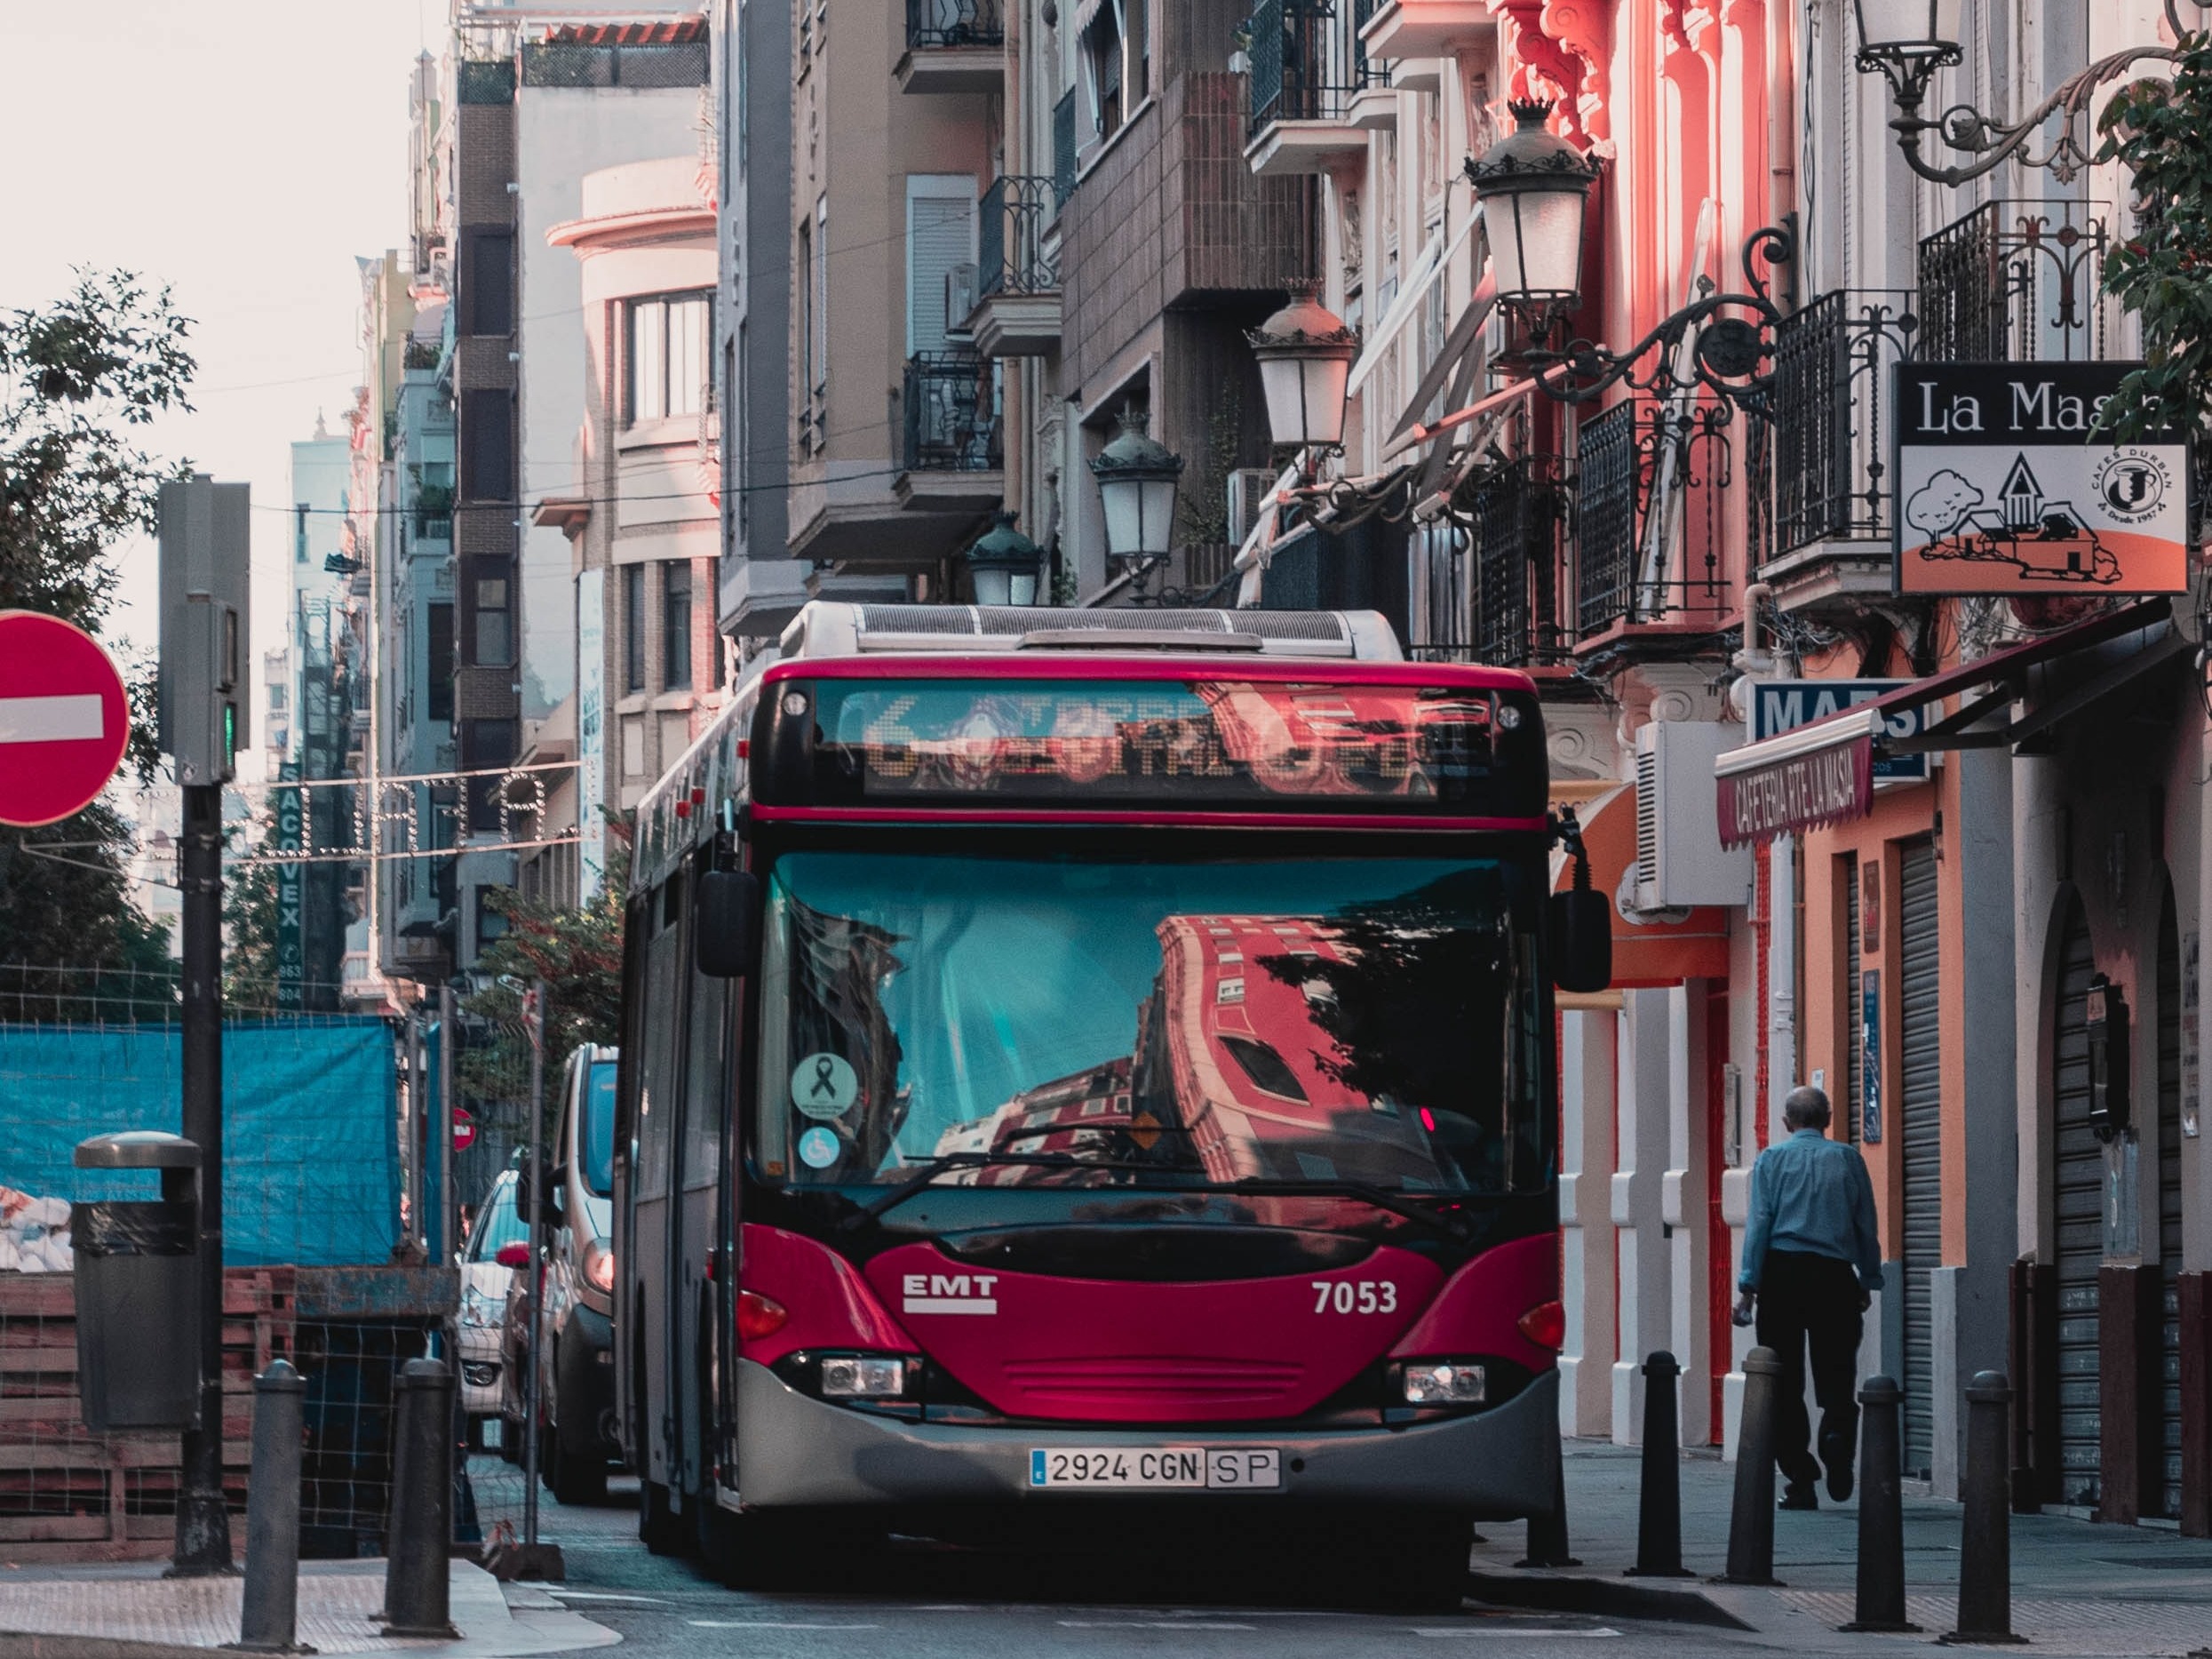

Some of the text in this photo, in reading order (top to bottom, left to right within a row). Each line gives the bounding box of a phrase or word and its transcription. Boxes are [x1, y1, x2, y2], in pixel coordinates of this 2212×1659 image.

[1916, 382, 2173, 434] La Mas
[2091, 449, 2172, 490] CAFES DURBAN
[2107, 510, 2134, 523] Desde
[863, 694, 919, 778] 6
[1736, 768, 1787, 833] CAFETERIA
[1787, 762, 1810, 822] RTE
[1824, 747, 1856, 813] MASIA
[280, 766, 301, 928] SACOVEX
[903, 1274, 998, 1296] EMT
[1311, 1280, 1397, 1314] 7053
[1053, 1454, 1129, 1480] 2924
[1140, 1454, 1197, 1480] CGN
